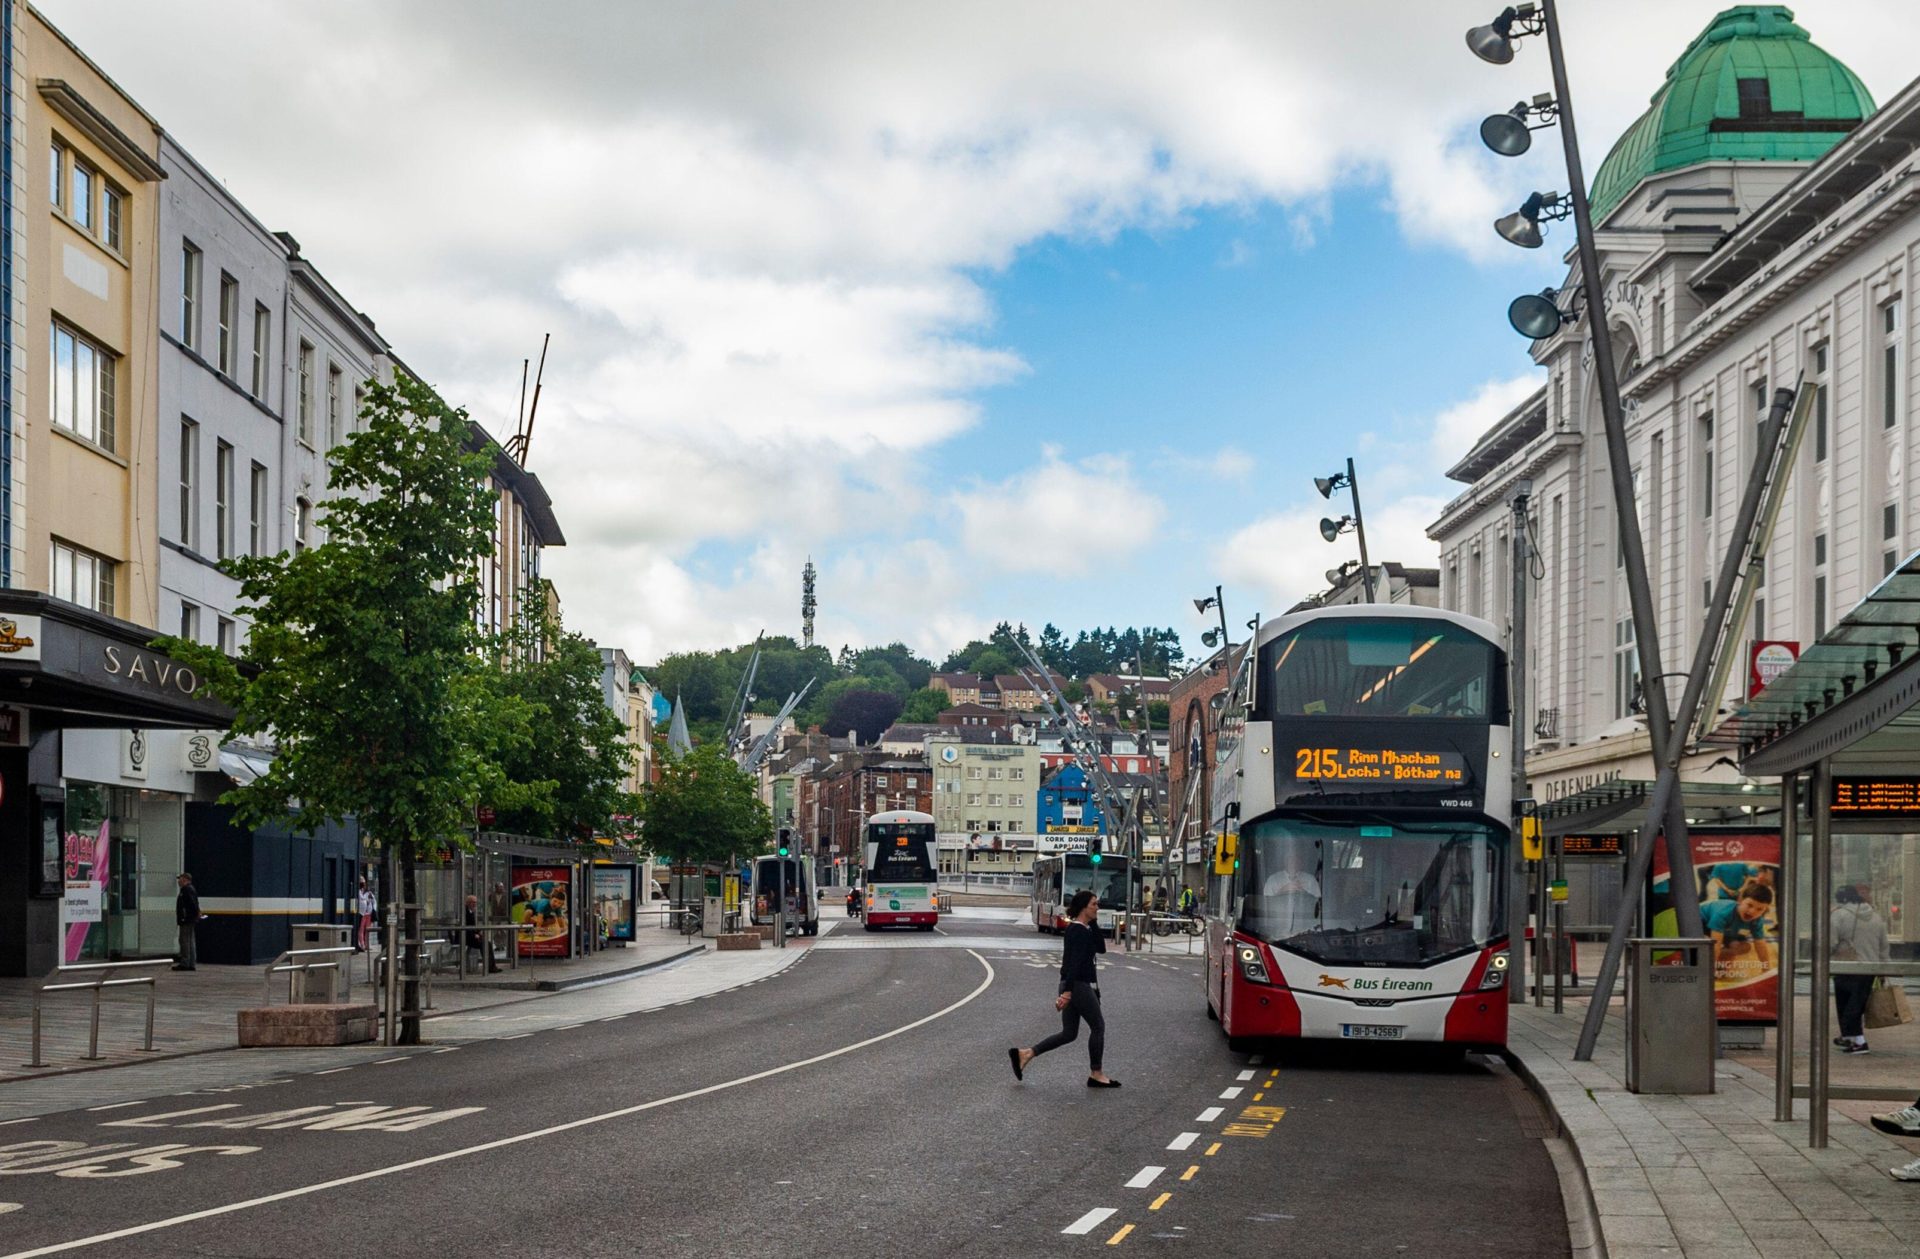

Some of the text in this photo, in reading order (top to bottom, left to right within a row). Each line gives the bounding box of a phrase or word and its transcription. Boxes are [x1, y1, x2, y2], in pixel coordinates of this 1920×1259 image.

[103, 646, 212, 698] SAVO
[1762, 665, 1789, 676] BUS
[188, 735, 212, 765] 3
[1350, 750, 1440, 765] Rinn Mhachan
[1296, 749, 1338, 778] 215
[1338, 763, 1381, 779] Locha
[1445, 770, 1462, 779] na
[1546, 769, 1621, 802] DEBENHAMS
[1732, 961, 1769, 970] FUTURE
[1354, 977, 1433, 991] Bus Éireann
[1650, 974, 1698, 984] Bruscar
[1352, 1027, 1398, 1036] 191-D-42569
